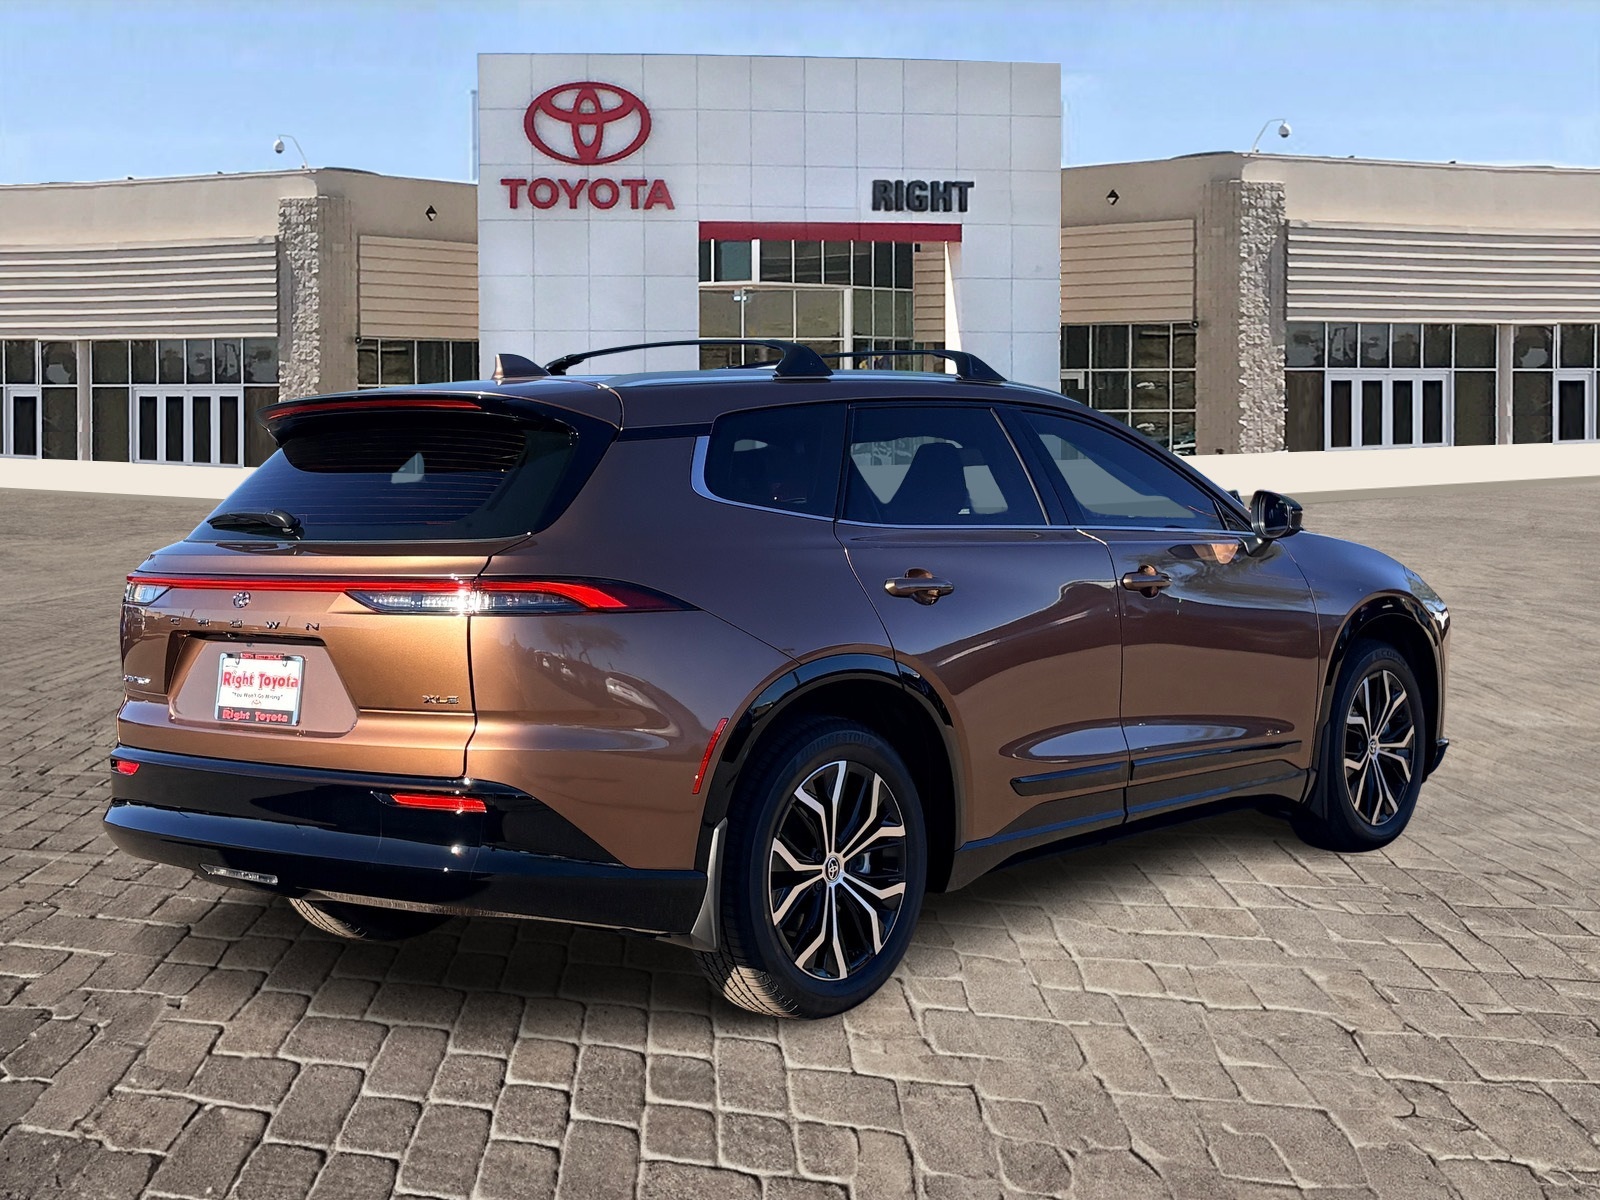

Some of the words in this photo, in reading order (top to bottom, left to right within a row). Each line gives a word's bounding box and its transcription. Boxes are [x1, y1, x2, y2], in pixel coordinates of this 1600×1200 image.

[500, 178, 675, 210] TOYOTA
[872, 179, 975, 212] RIGHT
[223, 671, 254, 689] Right
[258, 673, 299, 691] Toyota
[422, 694, 459, 705] XLE
[222, 708, 251, 721] Right
[255, 711, 289, 723] Toyota
